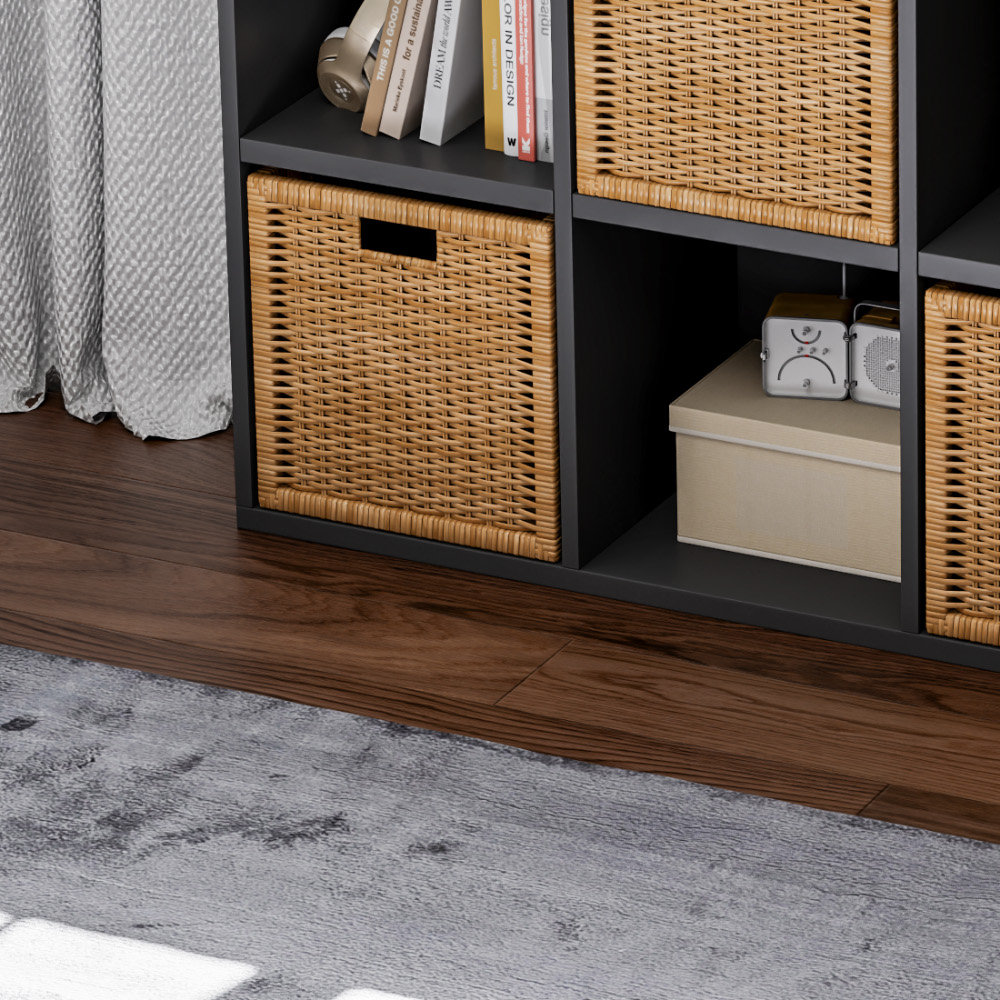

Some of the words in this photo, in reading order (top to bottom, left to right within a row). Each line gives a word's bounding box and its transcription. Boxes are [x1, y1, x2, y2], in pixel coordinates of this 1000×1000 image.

[386, 5, 399, 37] GOOD
[385, 39, 393, 47] A
[439, 39, 448, 49] the
[505, 30, 513, 45] IN
[382, 46, 391, 59] IS
[402, 47, 412, 61] for
[376, 58, 388, 80] THIS
[433, 48, 446, 89] DREAM
[505, 49, 515, 106] DESIGN
[507, 137, 517, 147] W
